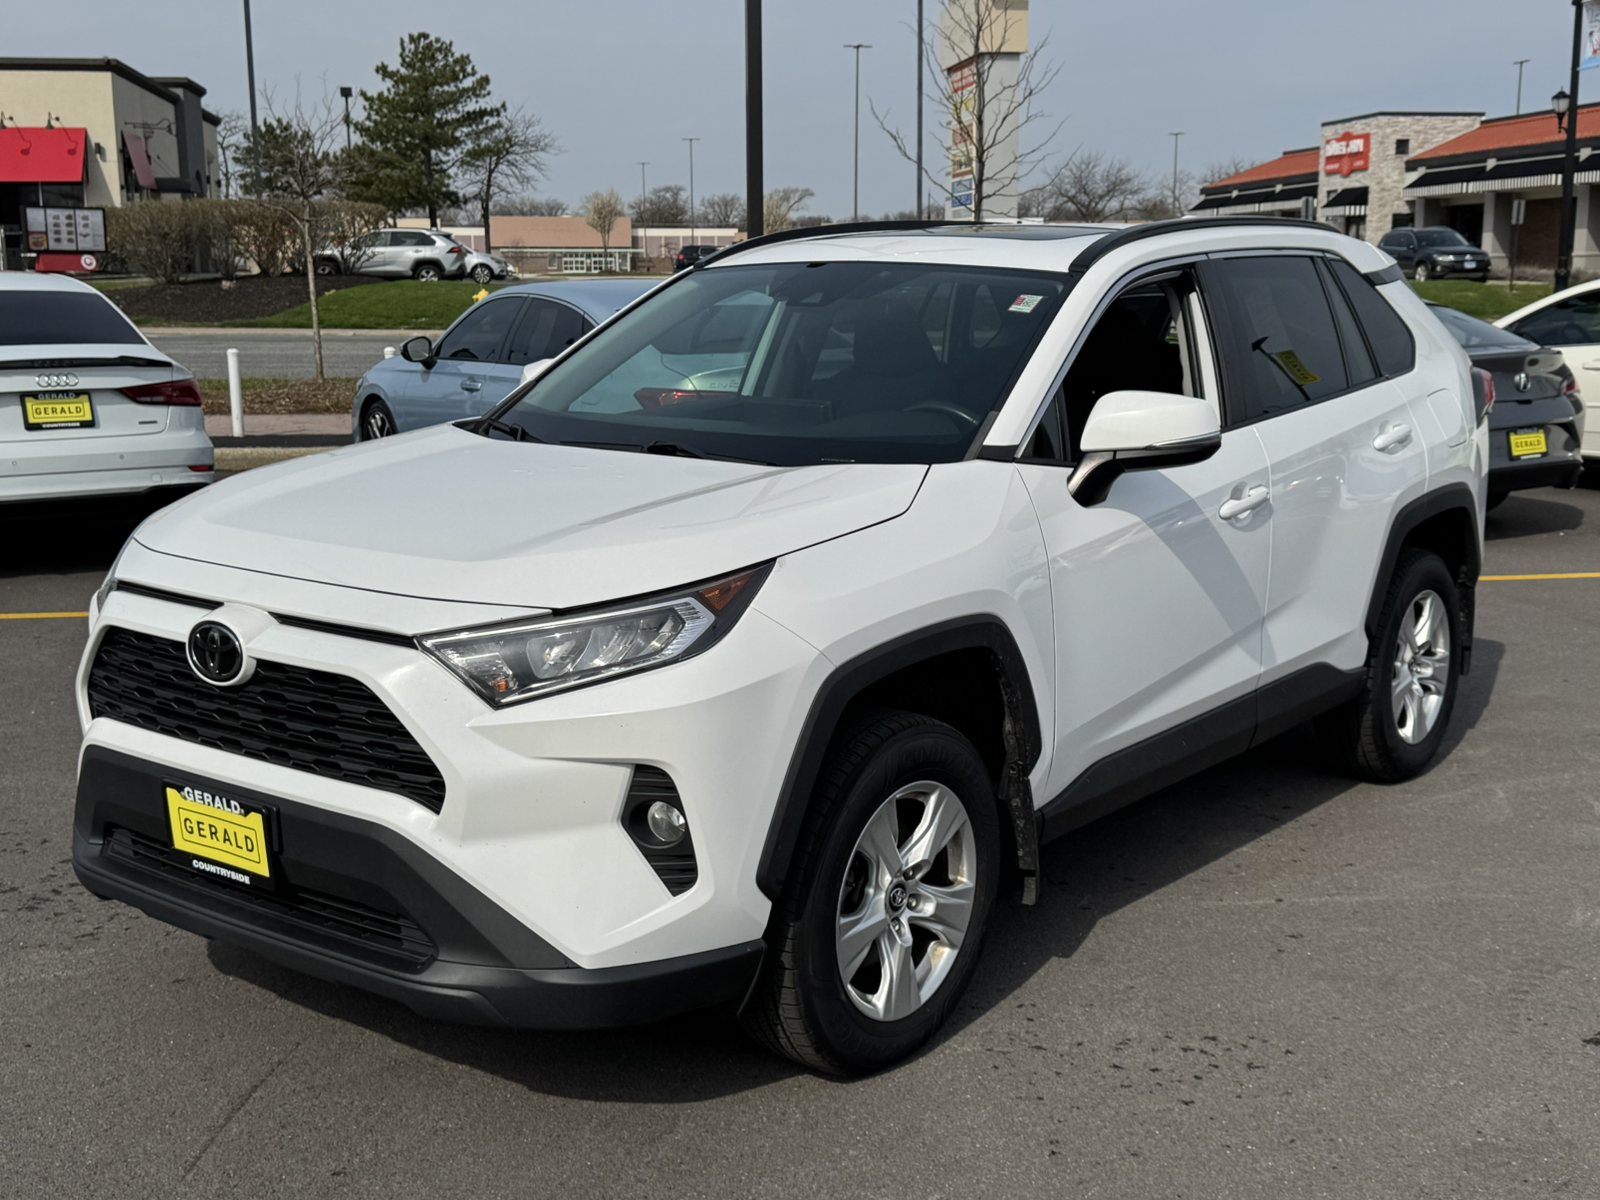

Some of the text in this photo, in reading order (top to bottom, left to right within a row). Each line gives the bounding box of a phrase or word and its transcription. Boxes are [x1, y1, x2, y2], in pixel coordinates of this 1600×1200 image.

[38, 392, 76, 400] GERALD
[35, 406, 82, 415] GERALD
[1515, 439, 1541, 448] GERALD
[184, 786, 241, 814] GERALD
[183, 817, 254, 852] GERALD
[192, 859, 251, 884] COUNTRYSIDE
